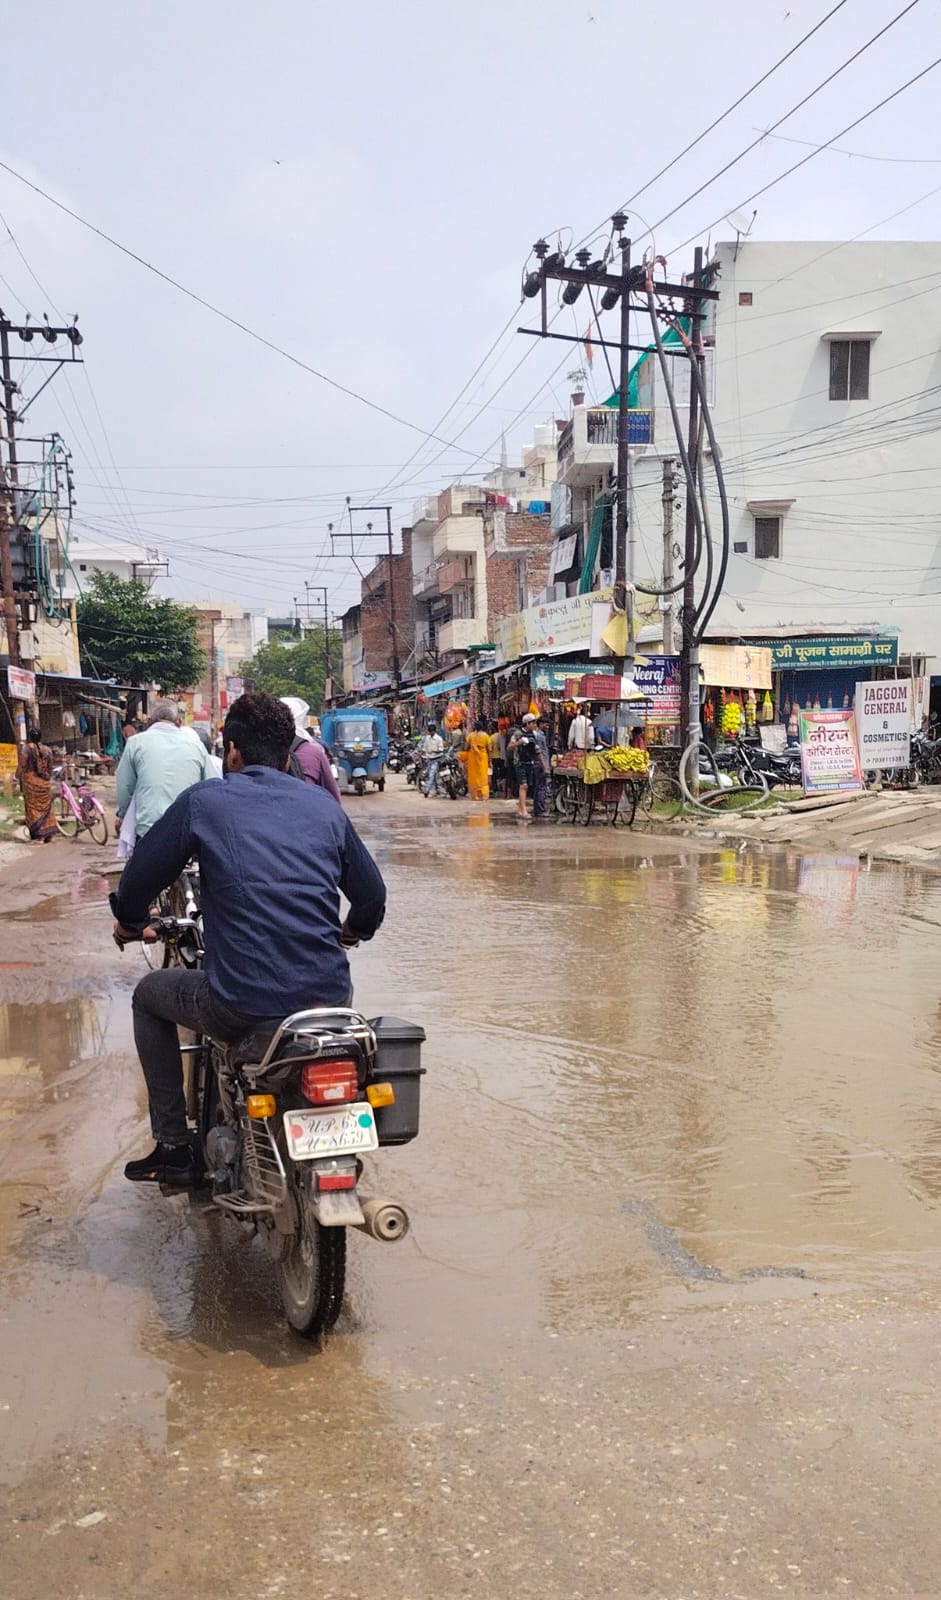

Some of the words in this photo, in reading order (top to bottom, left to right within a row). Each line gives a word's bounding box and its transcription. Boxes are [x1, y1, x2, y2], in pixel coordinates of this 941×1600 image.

[776, 644, 792, 658] जी
[795, 646, 826, 662] पूजन
[875, 644, 892, 655] घर
[632, 666, 665, 684] Neeraj
[864, 687, 907, 701] JAGGOM
[864, 702, 907, 715] GENERAL
[883, 720, 888, 729] &
[808, 725, 850, 742] नीरज
[863, 732, 908, 743] COSMETICS
